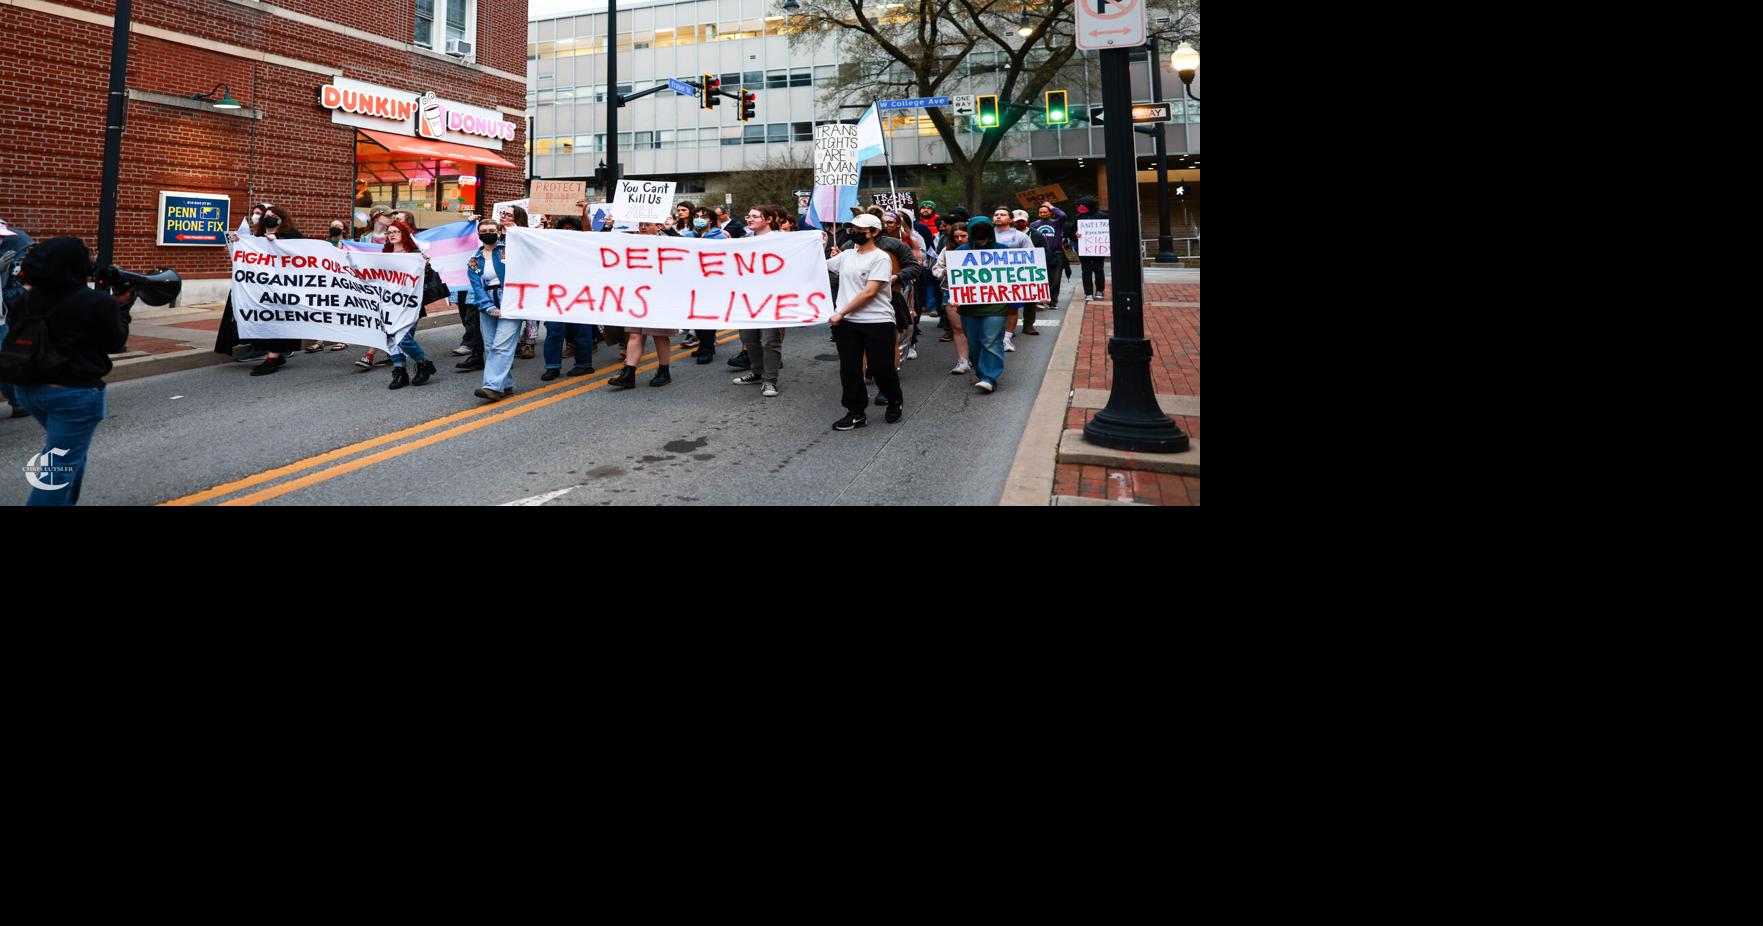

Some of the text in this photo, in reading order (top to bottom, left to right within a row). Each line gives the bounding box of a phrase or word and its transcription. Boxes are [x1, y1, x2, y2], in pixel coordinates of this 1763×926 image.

[891, 99, 924, 108] College
[324, 85, 514, 140] DUNKIN' DONUTS
[816, 124, 857, 138] TRANS
[815, 136, 858, 149] RIGHTS
[823, 149, 846, 161] ARE
[815, 161, 858, 173] HUMAN
[815, 173, 858, 185] RIGHTS
[535, 182, 583, 192] PROTECT
[622, 181, 639, 193] You
[628, 193, 662, 204] Kill Us
[875, 198, 914, 206] RIGHTS
[168, 206, 197, 218] PENN
[167, 219, 224, 232] PHONE FIX
[1085, 245, 1110, 254] KID
[233, 250, 277, 267] FIGHT
[281, 255, 319, 269] FOR
[321, 258, 345, 274] OUR
[599, 247, 785, 277] DEFEND
[961, 250, 1035, 267] ADMIN
[950, 266, 1047, 285] PROTECTS
[234, 269, 327, 288] ORGANIZE
[331, 276, 380, 296] AGAINST
[259, 291, 301, 306] AND
[305, 293, 340, 307] THE
[949, 283, 1050, 303] THE FAR-RIGHT
[505, 283, 827, 323] TRANS LIVES
[239, 308, 332, 324] VIOLENCE
[336, 312, 373, 329] THEY
